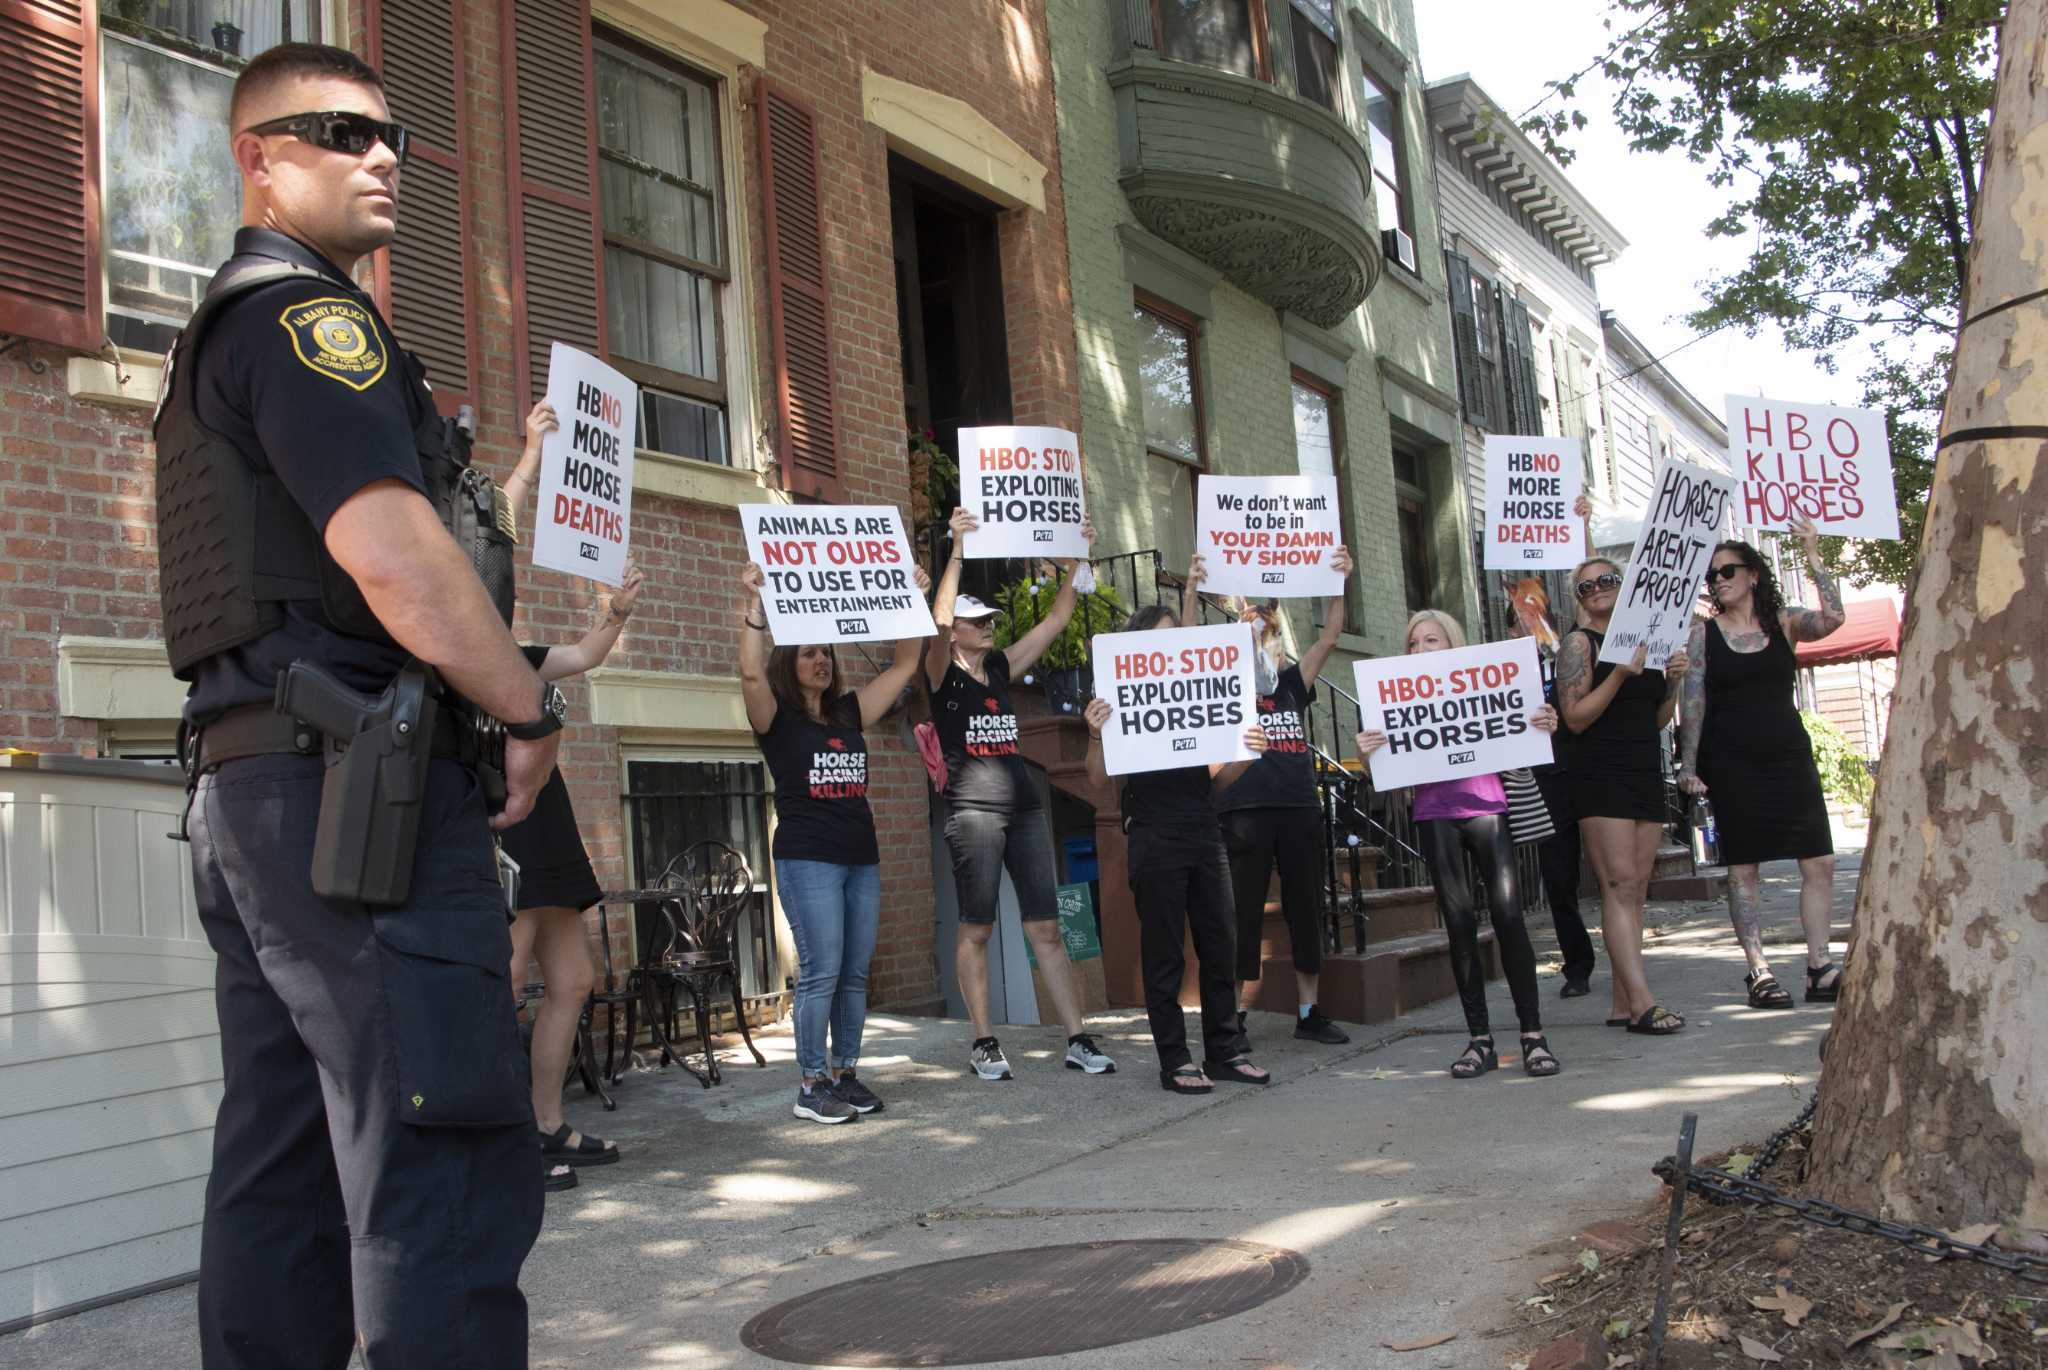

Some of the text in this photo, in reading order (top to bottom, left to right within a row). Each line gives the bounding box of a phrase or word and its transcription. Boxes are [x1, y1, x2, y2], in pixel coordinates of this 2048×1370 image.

[292, 305, 368, 328] ALBANY POLICE
[576, 380, 622, 429] HBNO
[572, 419, 620, 467] MORE
[1744, 407, 1859, 459] HBO
[979, 446, 1076, 473] HBO: STOP
[1508, 453, 1560, 473] HBNO
[1746, 448, 1860, 487] KILLS
[563, 455, 621, 505] HORSE
[981, 475, 1079, 498] EXPLOITING
[1508, 476, 1561, 496] MORE
[982, 499, 1081, 524] HORSES
[1216, 494, 1327, 511] We don't want
[1503, 501, 1565, 520] HORSE
[1653, 467, 1729, 531] HORSES
[1742, 480, 1864, 526] HORSES
[553, 492, 624, 545] DEATHS
[758, 516, 893, 536] ANIMALS ARE
[1245, 512, 1304, 529] to be in
[1210, 530, 1334, 548] YOUR DAMN
[1497, 524, 1571, 544] DEATHS
[761, 540, 901, 566] NOT OURS
[1223, 549, 1322, 566] TV SHOW
[768, 569, 908, 593] TO USE FOR
[775, 595, 912, 614] ENTERTAINMENT
[1628, 567, 1700, 630] PROPS!
[1114, 645, 1240, 680] HBO: STOP
[1117, 675, 1242, 707] EXPLOITING
[1378, 674, 1444, 704] HBO:
[1449, 661, 1520, 694] STOP
[968, 714, 1017, 730] HORSE
[1120, 701, 1244, 736] HORSES
[1257, 711, 1300, 726] ORSE
[1383, 689, 1524, 730] EXPLOITING
[1388, 713, 1528, 755] HORSES
[813, 752, 866, 768] HORSE
[809, 768, 866, 785] RACING
